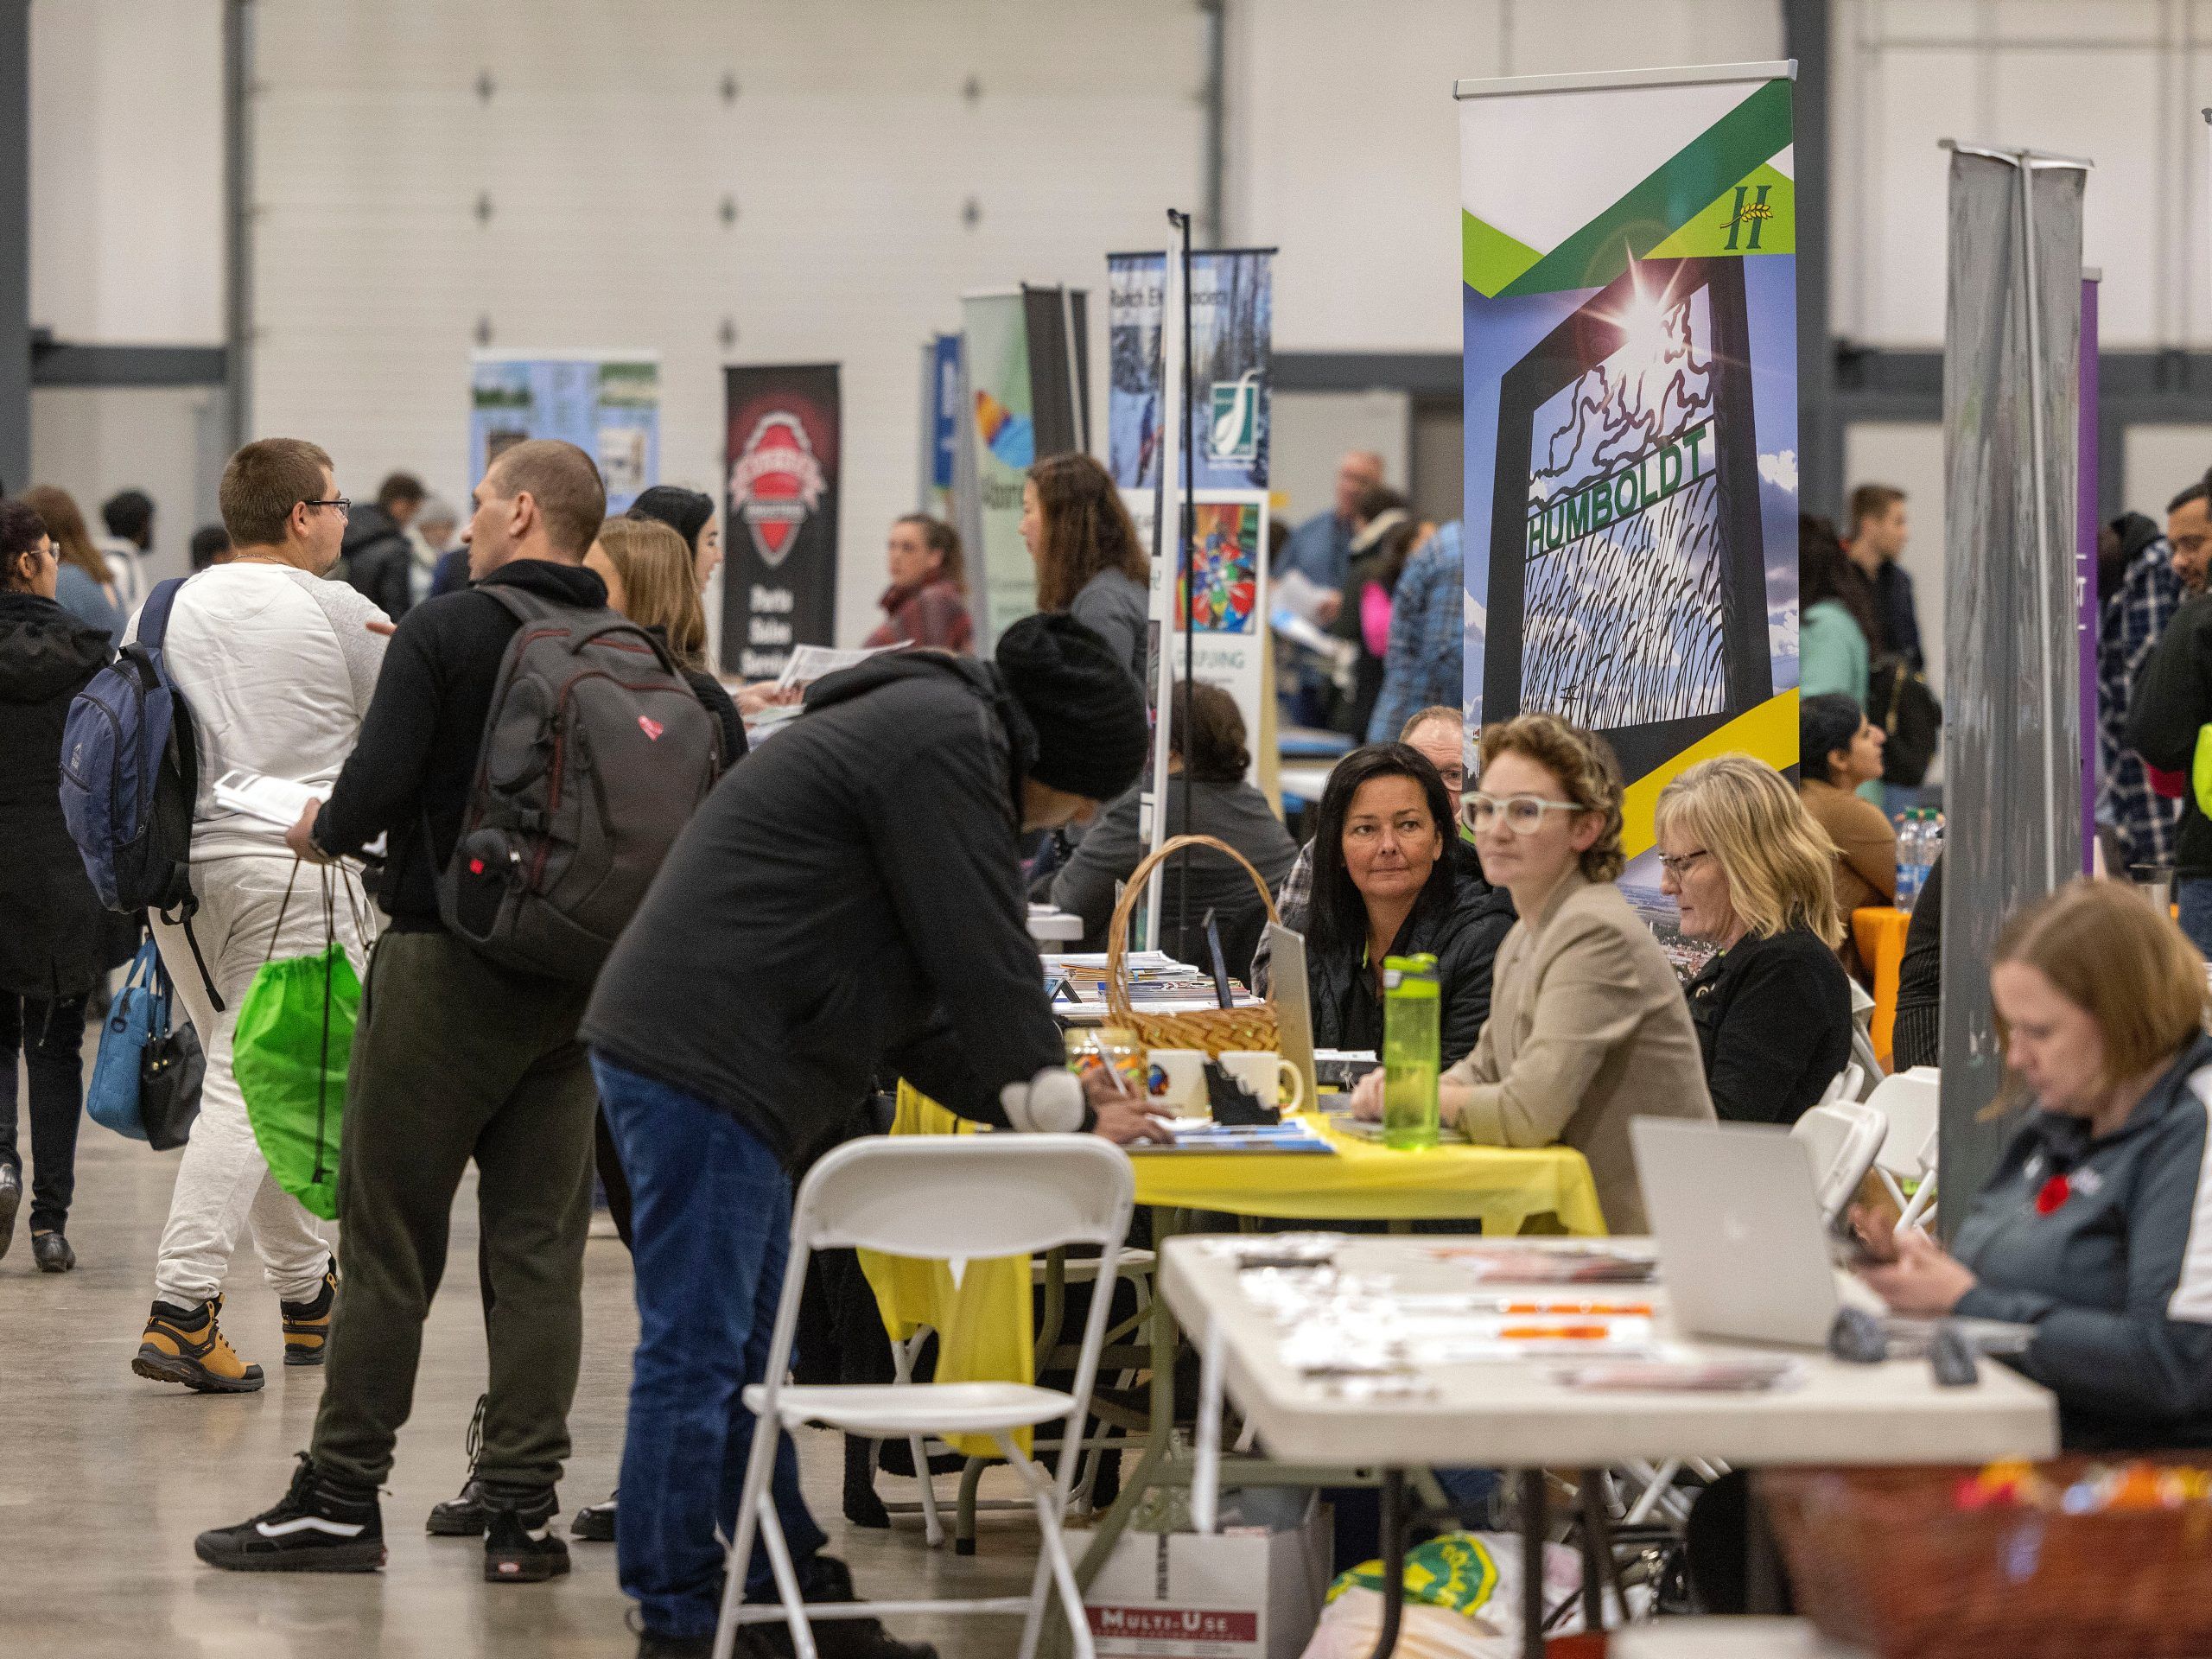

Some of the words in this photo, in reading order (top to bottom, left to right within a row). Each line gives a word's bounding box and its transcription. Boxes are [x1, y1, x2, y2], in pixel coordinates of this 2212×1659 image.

[1724, 184, 1772, 251] H
[1529, 427, 1707, 557] HUMBOLDT
[1101, 1608, 1227, 1631] MULTI-USE
